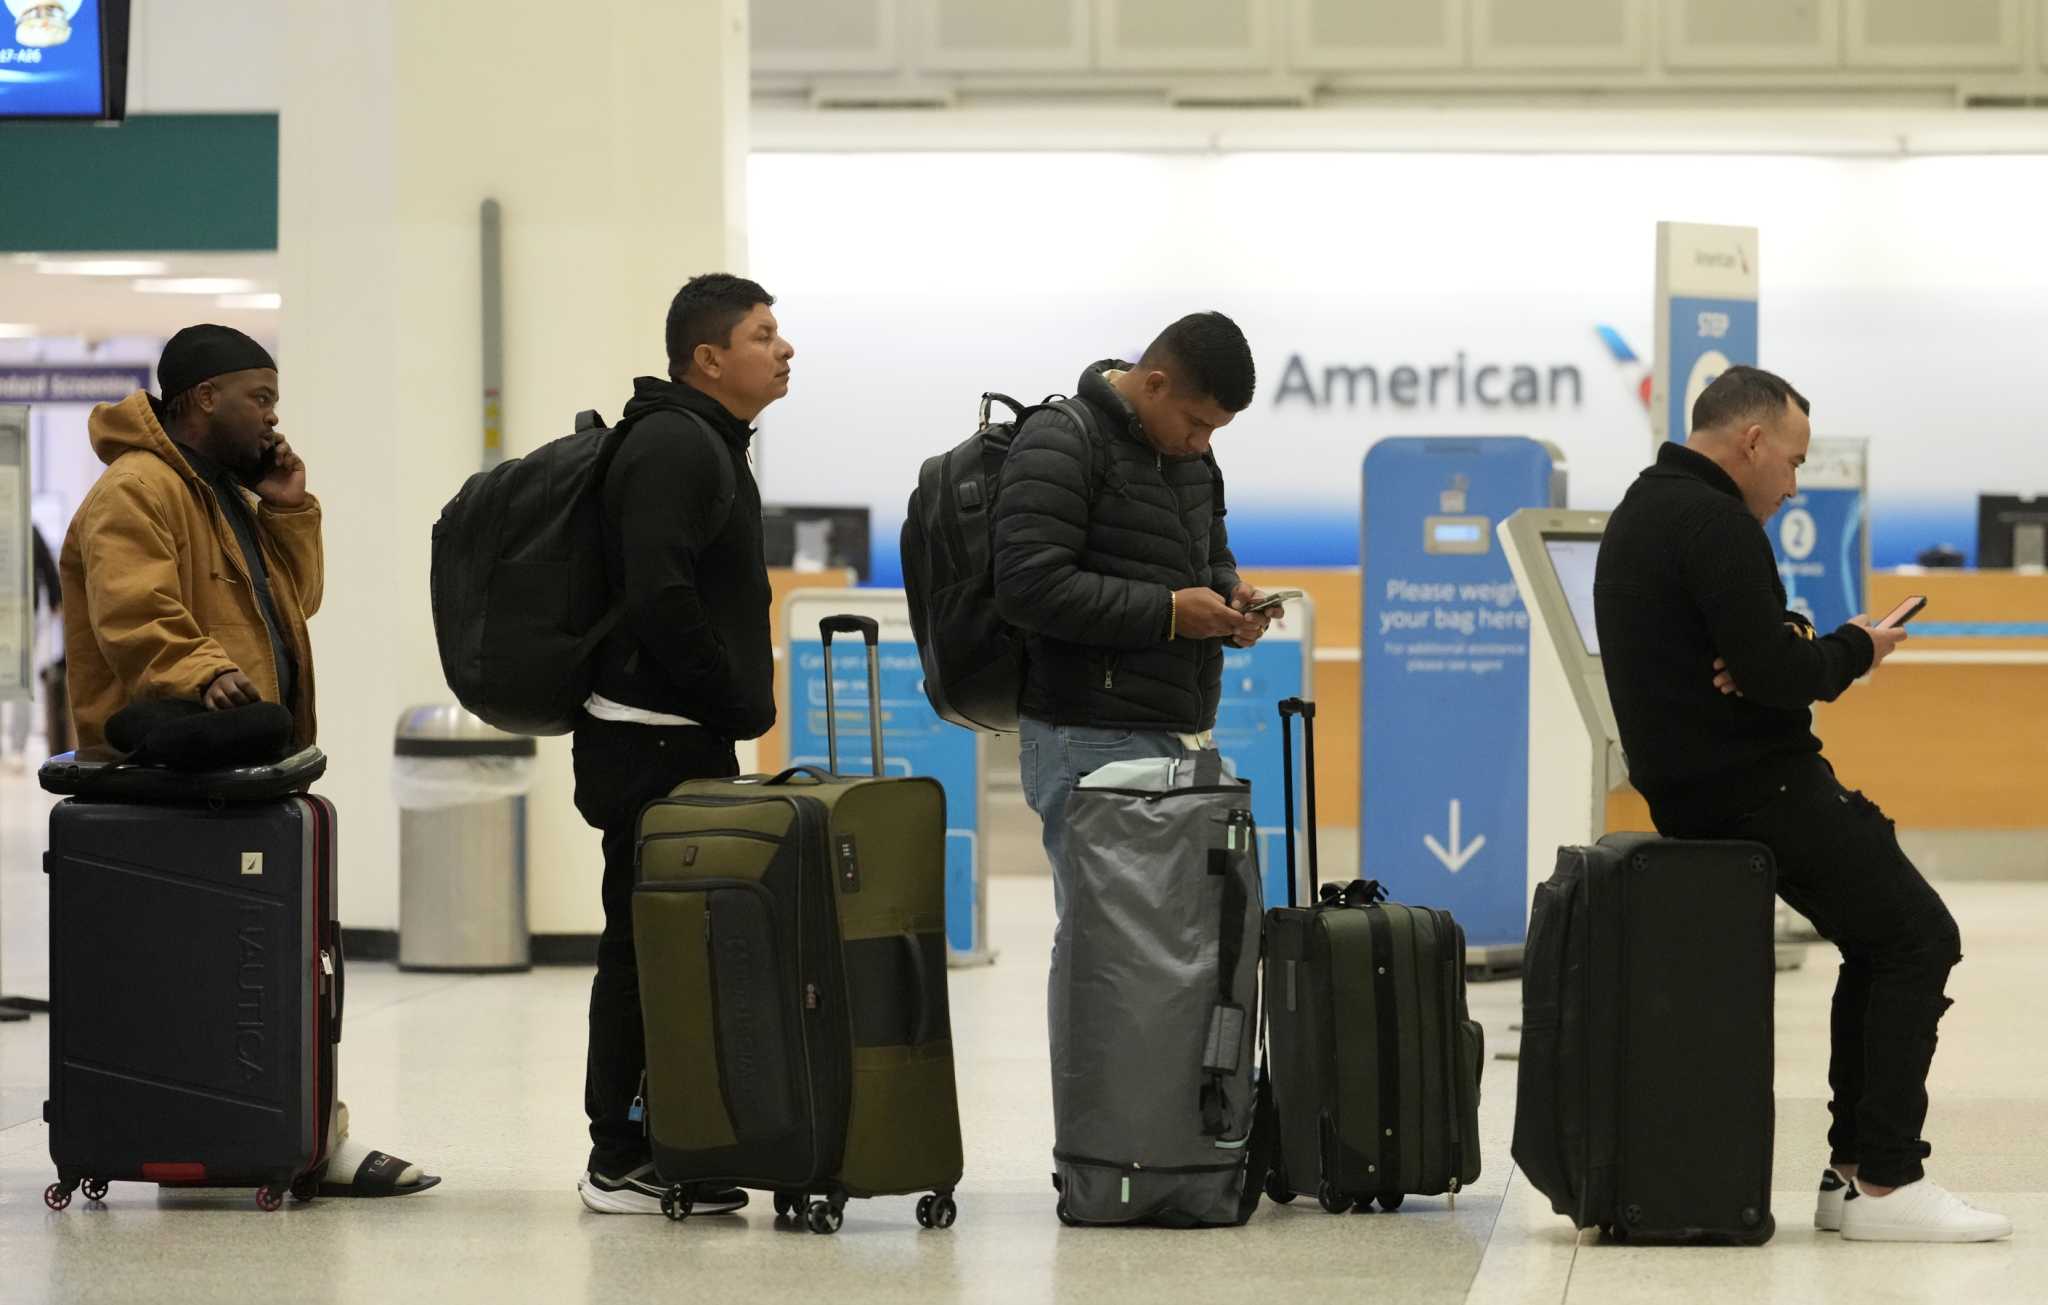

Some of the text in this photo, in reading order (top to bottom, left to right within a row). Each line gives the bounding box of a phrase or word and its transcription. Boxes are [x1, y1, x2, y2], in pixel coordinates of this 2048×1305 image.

[1273, 352, 1583, 408] American
[1386, 579, 1455, 602] Please
[1379, 606, 1529, 636] your bag here
[236, 904, 265, 1082] NAUTICA
